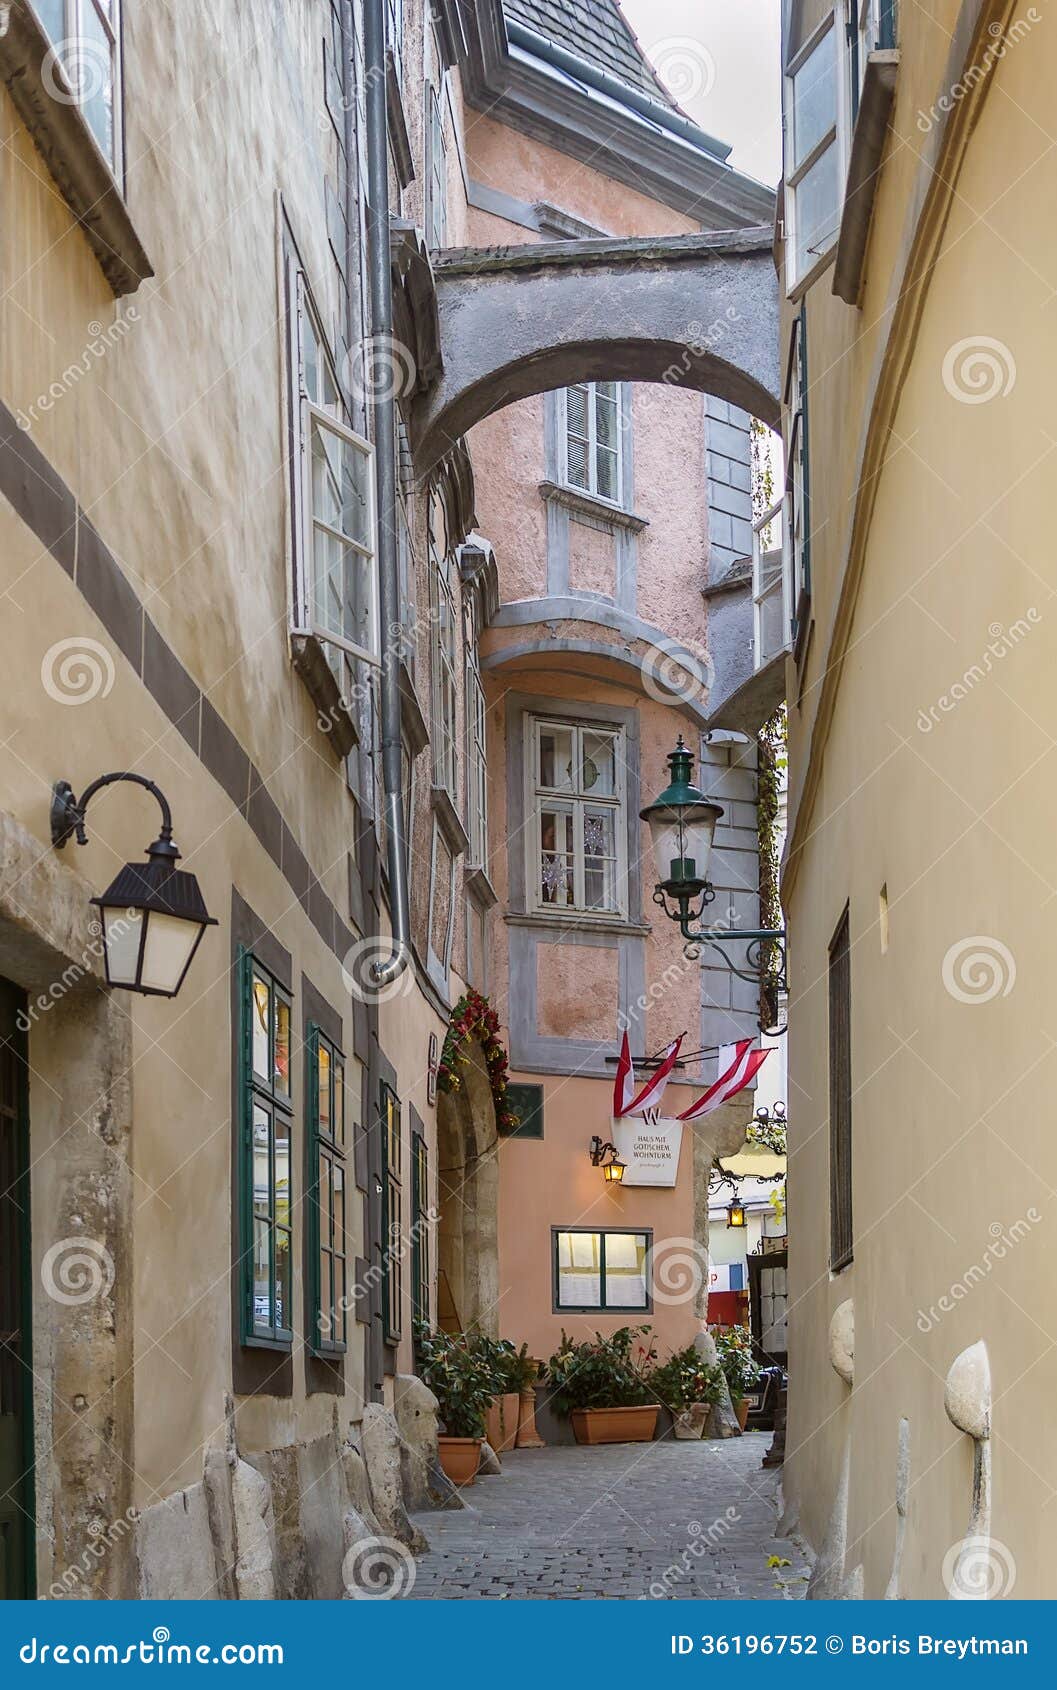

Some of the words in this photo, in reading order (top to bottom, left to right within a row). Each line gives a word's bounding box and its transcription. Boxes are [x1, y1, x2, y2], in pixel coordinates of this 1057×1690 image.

[642, 1107, 661, 1126] W
[633, 1143, 670, 1151] GOTISCHEM
[633, 1151, 672, 1160] WOHNTURM
